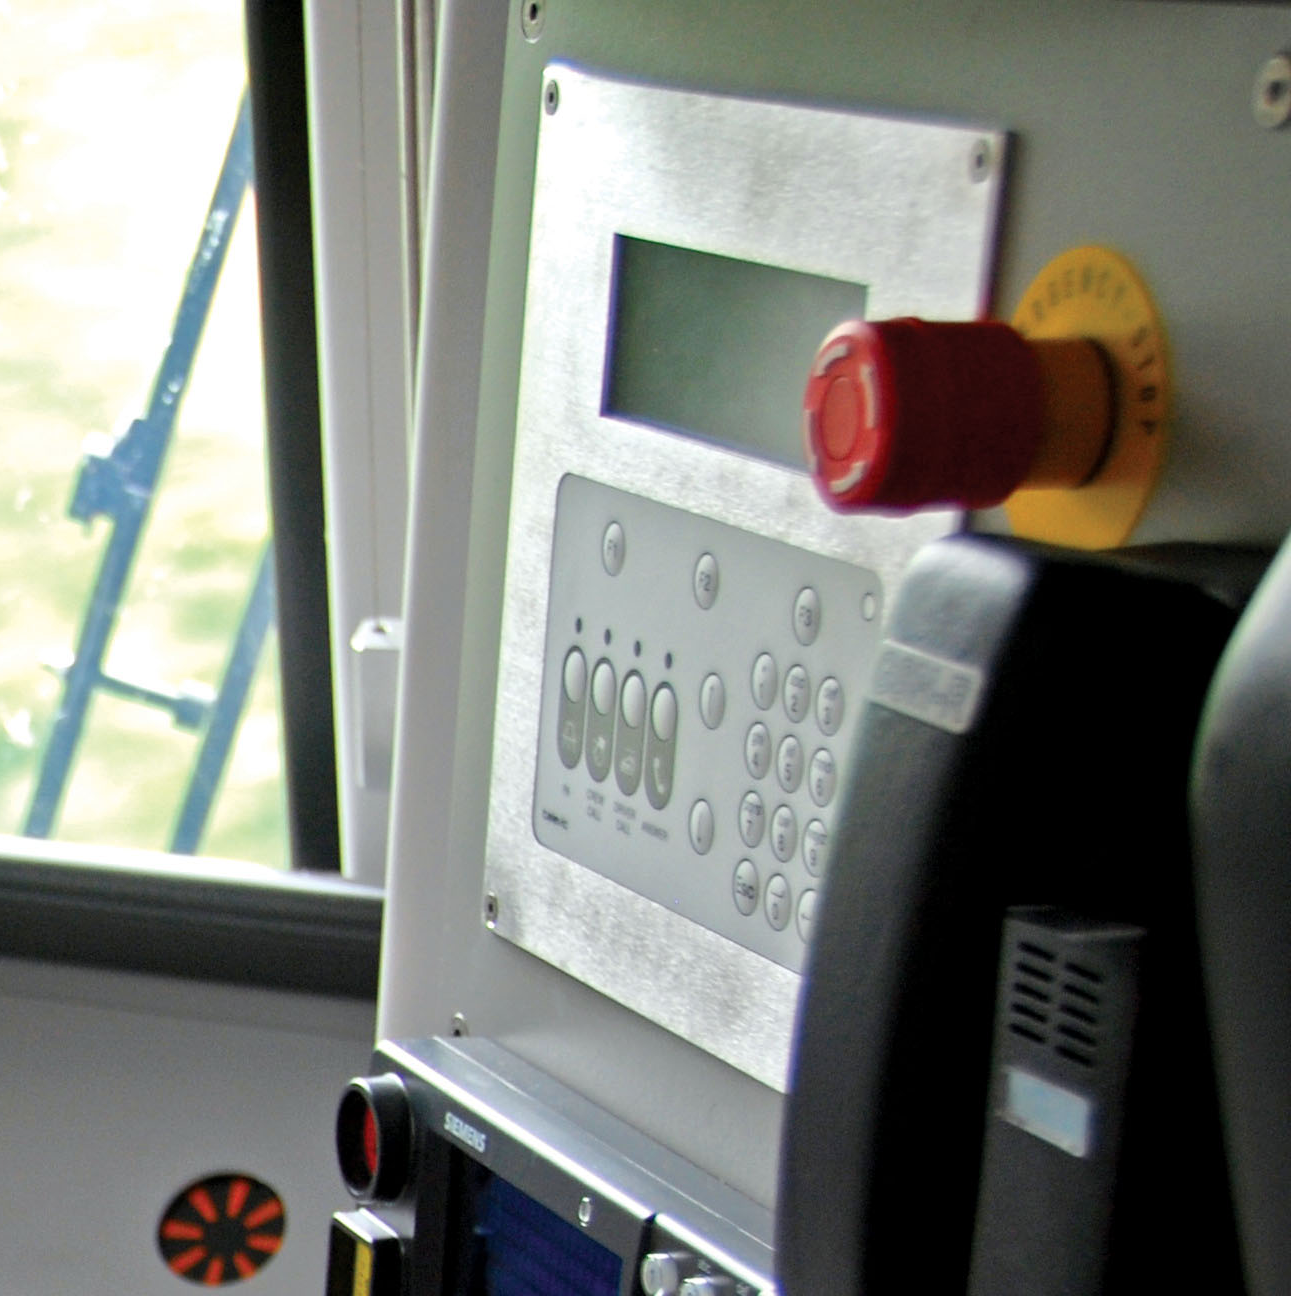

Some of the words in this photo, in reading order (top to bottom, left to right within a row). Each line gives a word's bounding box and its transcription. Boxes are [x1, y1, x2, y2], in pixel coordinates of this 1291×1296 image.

[699, 570, 713, 592] F2
[798, 604, 813, 627] F3
[444, 1111, 487, 1153] SIEMENS
